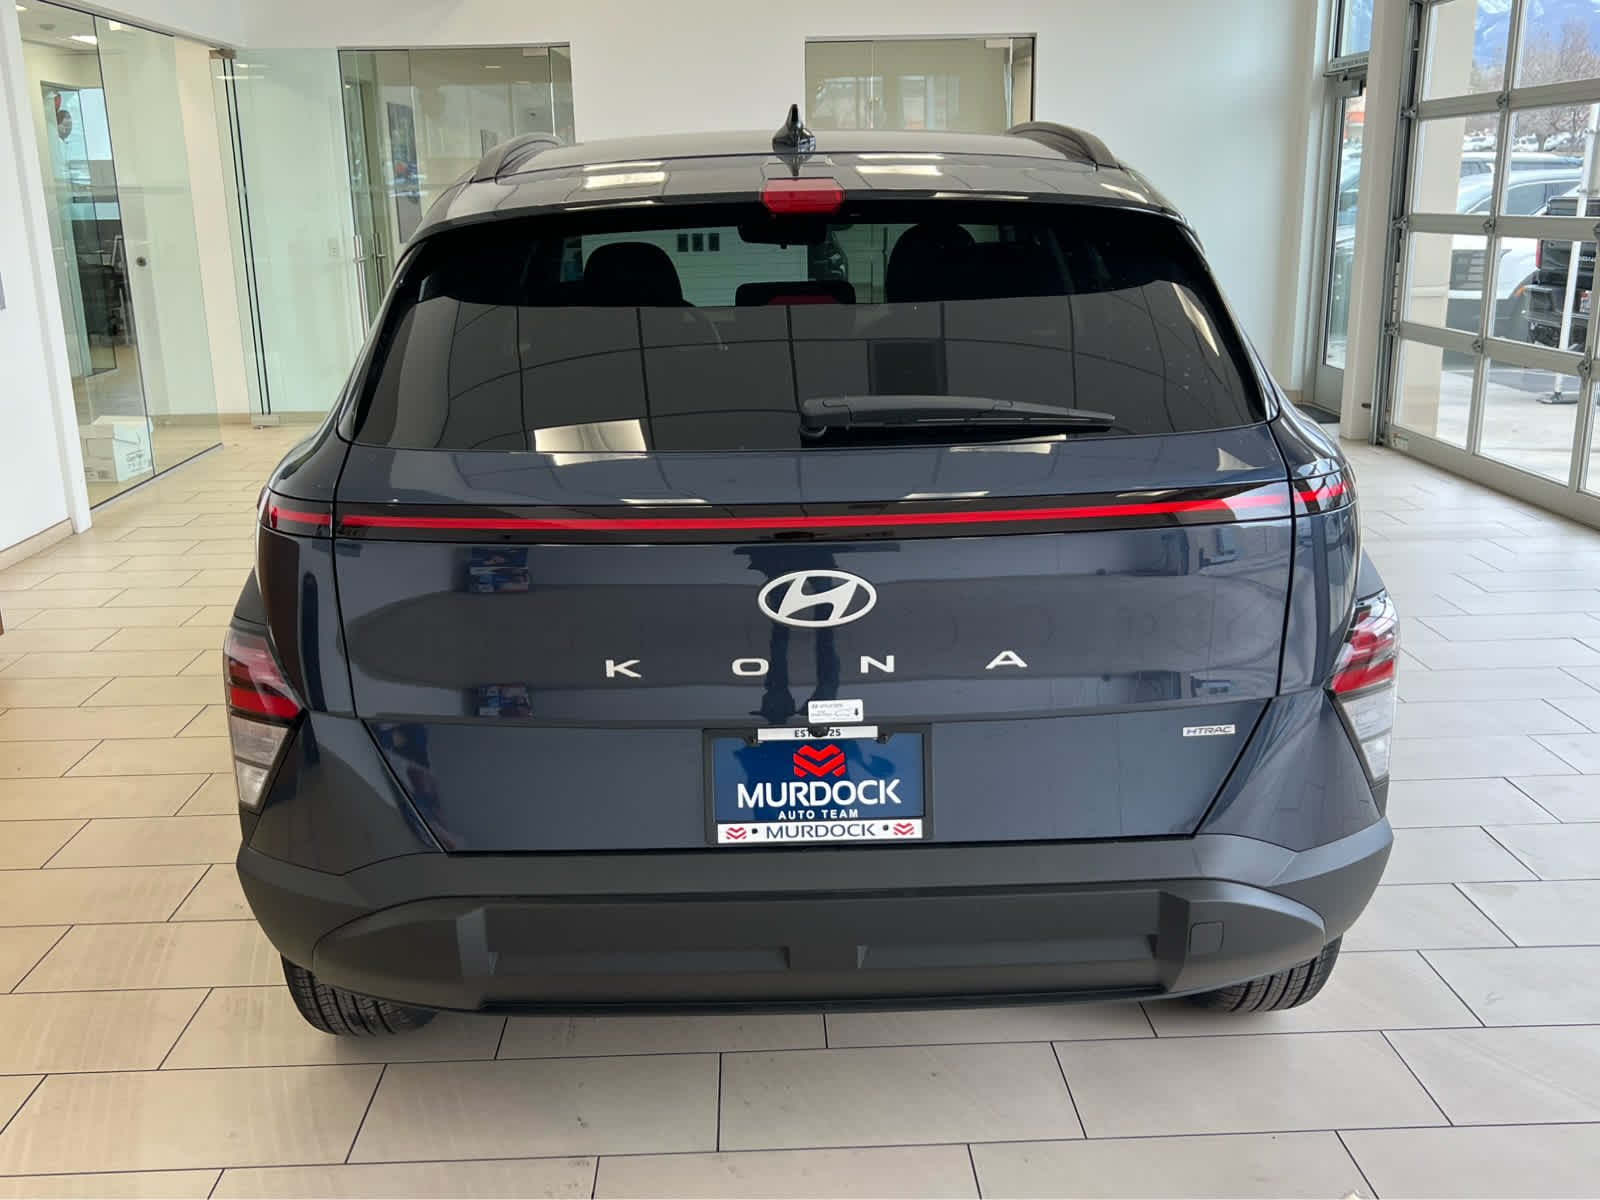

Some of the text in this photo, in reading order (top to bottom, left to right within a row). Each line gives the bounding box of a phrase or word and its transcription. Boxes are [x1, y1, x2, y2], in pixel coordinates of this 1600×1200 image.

[605, 650, 1028, 678] KONA
[1186, 726, 1233, 735] HTRAC
[737, 779, 902, 809] MURDOCK
[778, 808, 859, 820] AUTO TEAM
[766, 823, 876, 840] MURDOCK
